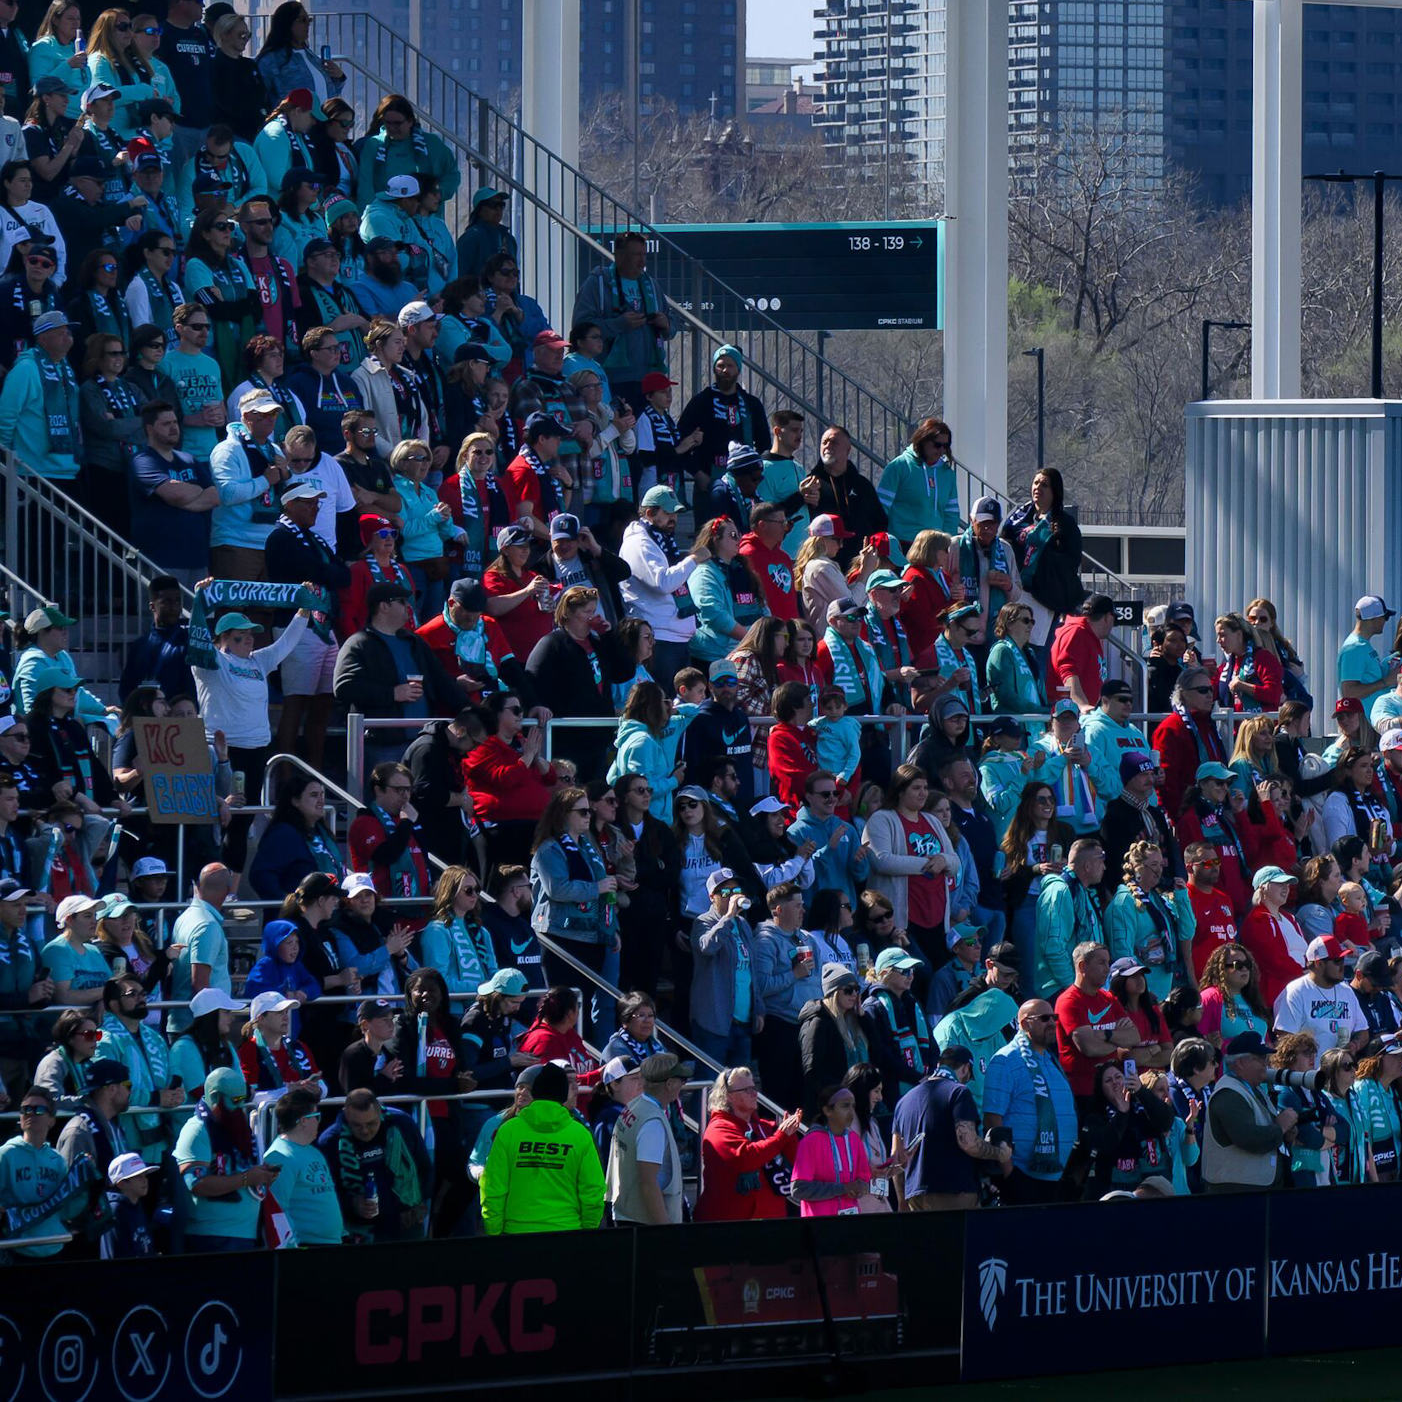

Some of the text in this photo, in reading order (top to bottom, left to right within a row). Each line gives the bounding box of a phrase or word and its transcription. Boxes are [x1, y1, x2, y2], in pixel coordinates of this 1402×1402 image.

[176, 43, 206, 55] CURRENT
[6, 220, 46, 233] CUENT
[849, 237, 870, 251] 138
[882, 236, 905, 249] 139
[260, 277, 270, 304] KC
[228, 583, 300, 604] CURRENT
[1115, 606, 1134, 620] 38
[144, 724, 185, 766] KC
[153, 774, 219, 818] BABY
[518, 1141, 574, 1157] BEST
[765, 1287, 795, 1300] CPKC
[1016, 1278, 1066, 1318] THE
[1075, 1270, 1218, 1313] UNIVERSITY
[1225, 1267, 1256, 1301] OF
[1270, 1258, 1359, 1297] KANSAS
[355, 1278, 557, 1365] CPKC
